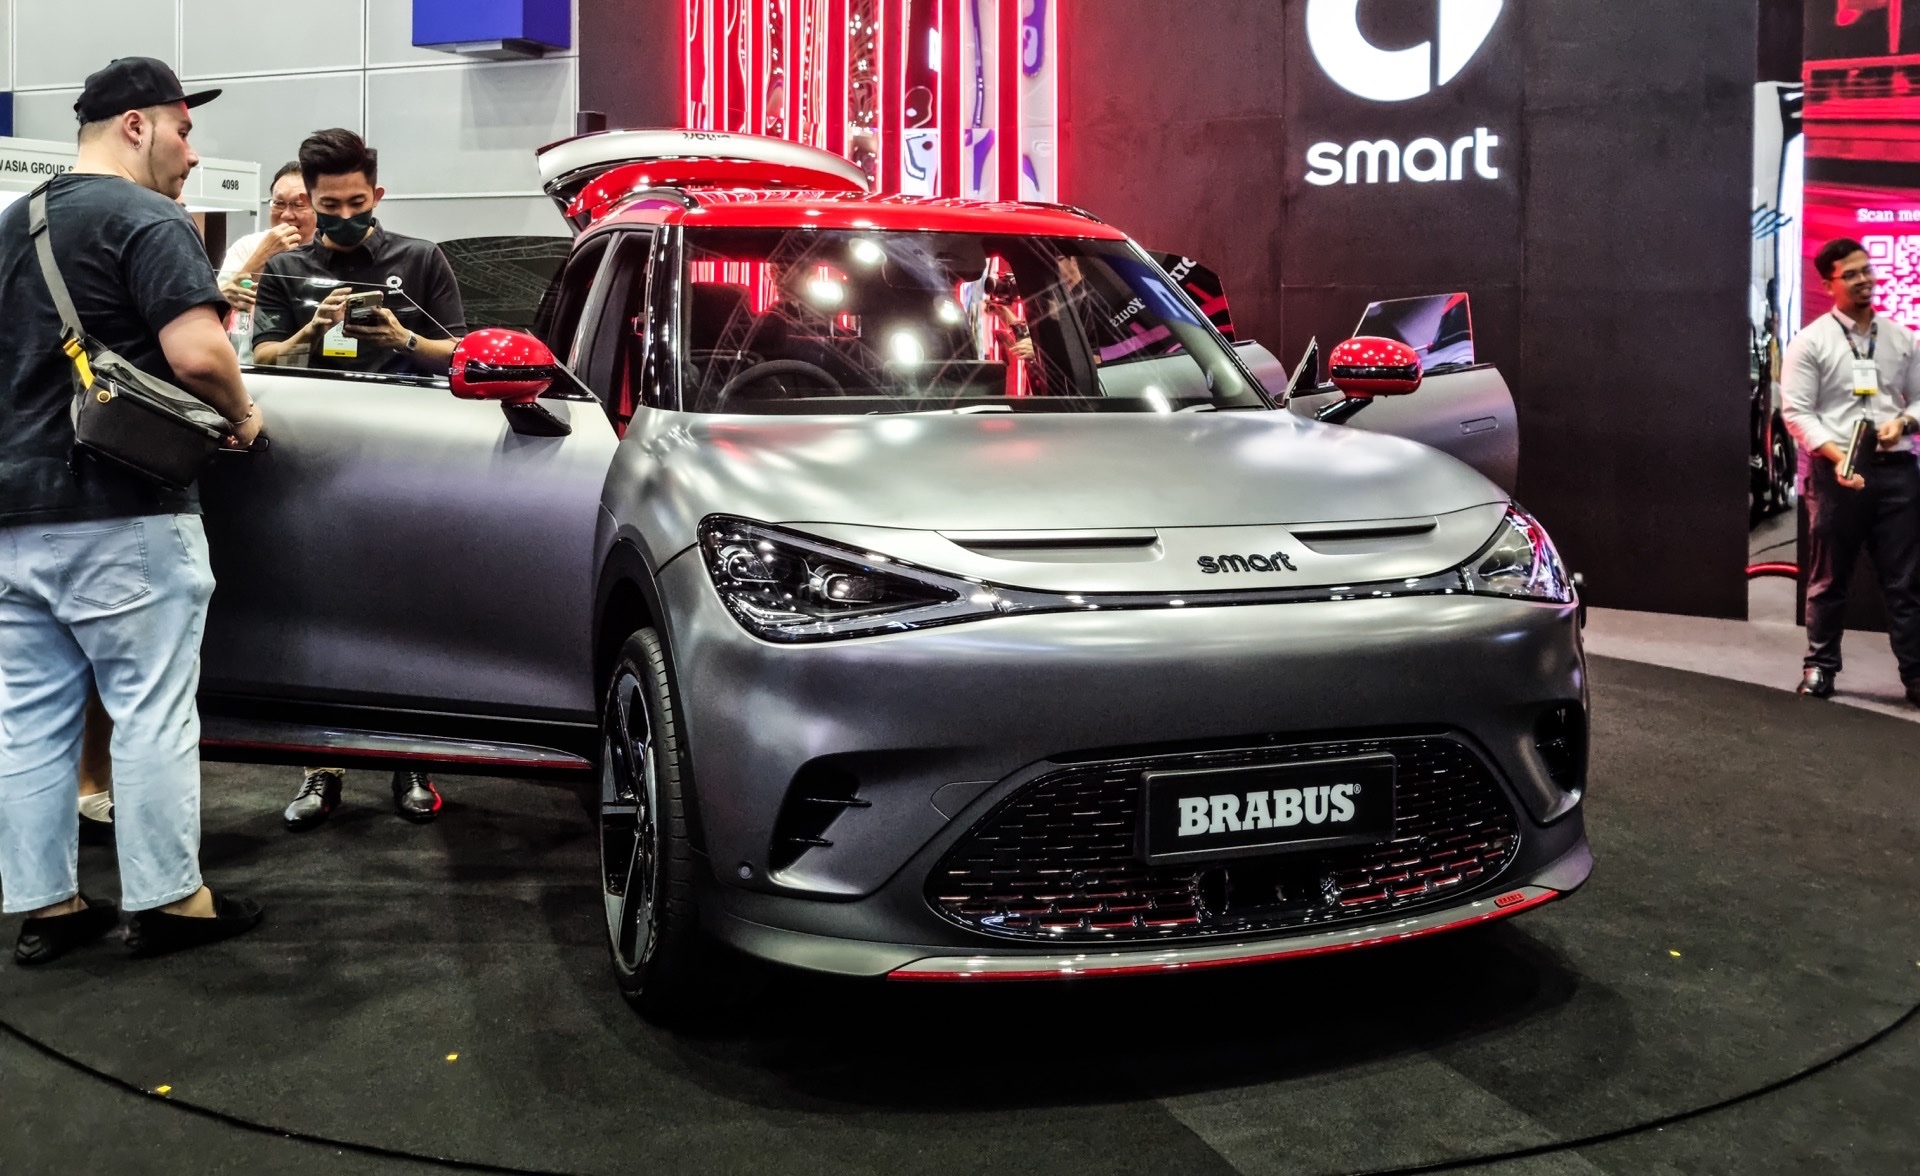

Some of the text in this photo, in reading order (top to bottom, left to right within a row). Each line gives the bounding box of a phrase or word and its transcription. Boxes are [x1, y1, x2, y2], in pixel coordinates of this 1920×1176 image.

[1304, 127, 1498, 186] smart
[5, 160, 28, 173] ASIA
[31, 162, 65, 175] GROUP
[222, 179, 239, 190] 4098
[1857, 208, 1920, 222] Scan me
[1197, 551, 1297, 573] smart
